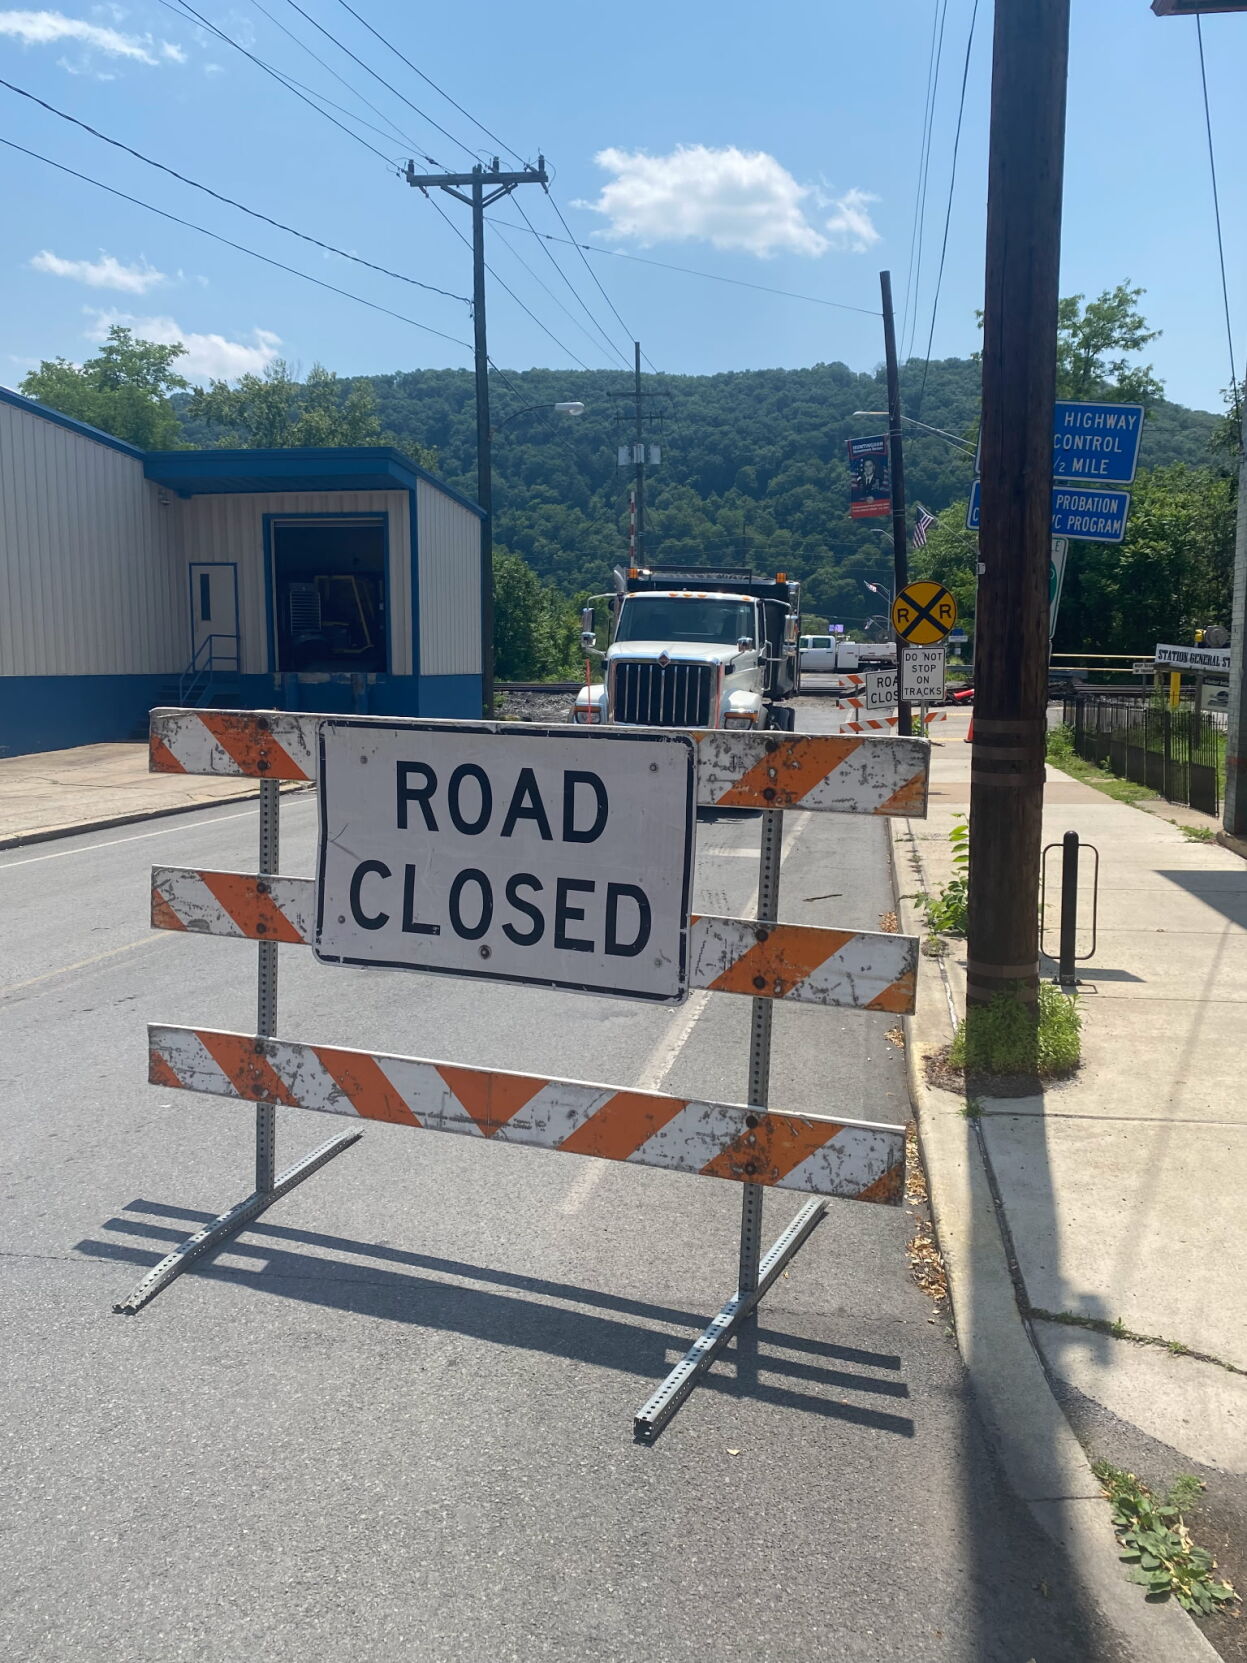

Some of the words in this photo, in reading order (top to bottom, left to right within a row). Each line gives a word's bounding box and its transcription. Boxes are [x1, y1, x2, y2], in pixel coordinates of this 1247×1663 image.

[1064, 412, 1137, 431] HIGHWAY
[1053, 433, 1122, 453] CONTROL
[1072, 458, 1109, 474] MILE
[1056, 494, 1119, 514] PROBATION
[1066, 515, 1122, 534] PROGRAM
[897, 608, 909, 623] R
[939, 604, 951, 618] R
[905, 653, 918, 662] DO
[923, 652, 943, 662] NOT
[1190, 652, 1221, 667] GENERAL
[1222, 656, 1230, 667] ST
[911, 664, 937, 673] STOP
[877, 676, 899, 689] ROA
[916, 676, 930, 684] ON
[870, 690, 899, 704] CLOS
[904, 687, 942, 696] TRACKS
[396, 760, 609, 844] ROAD
[349, 859, 652, 958] CLOSED
